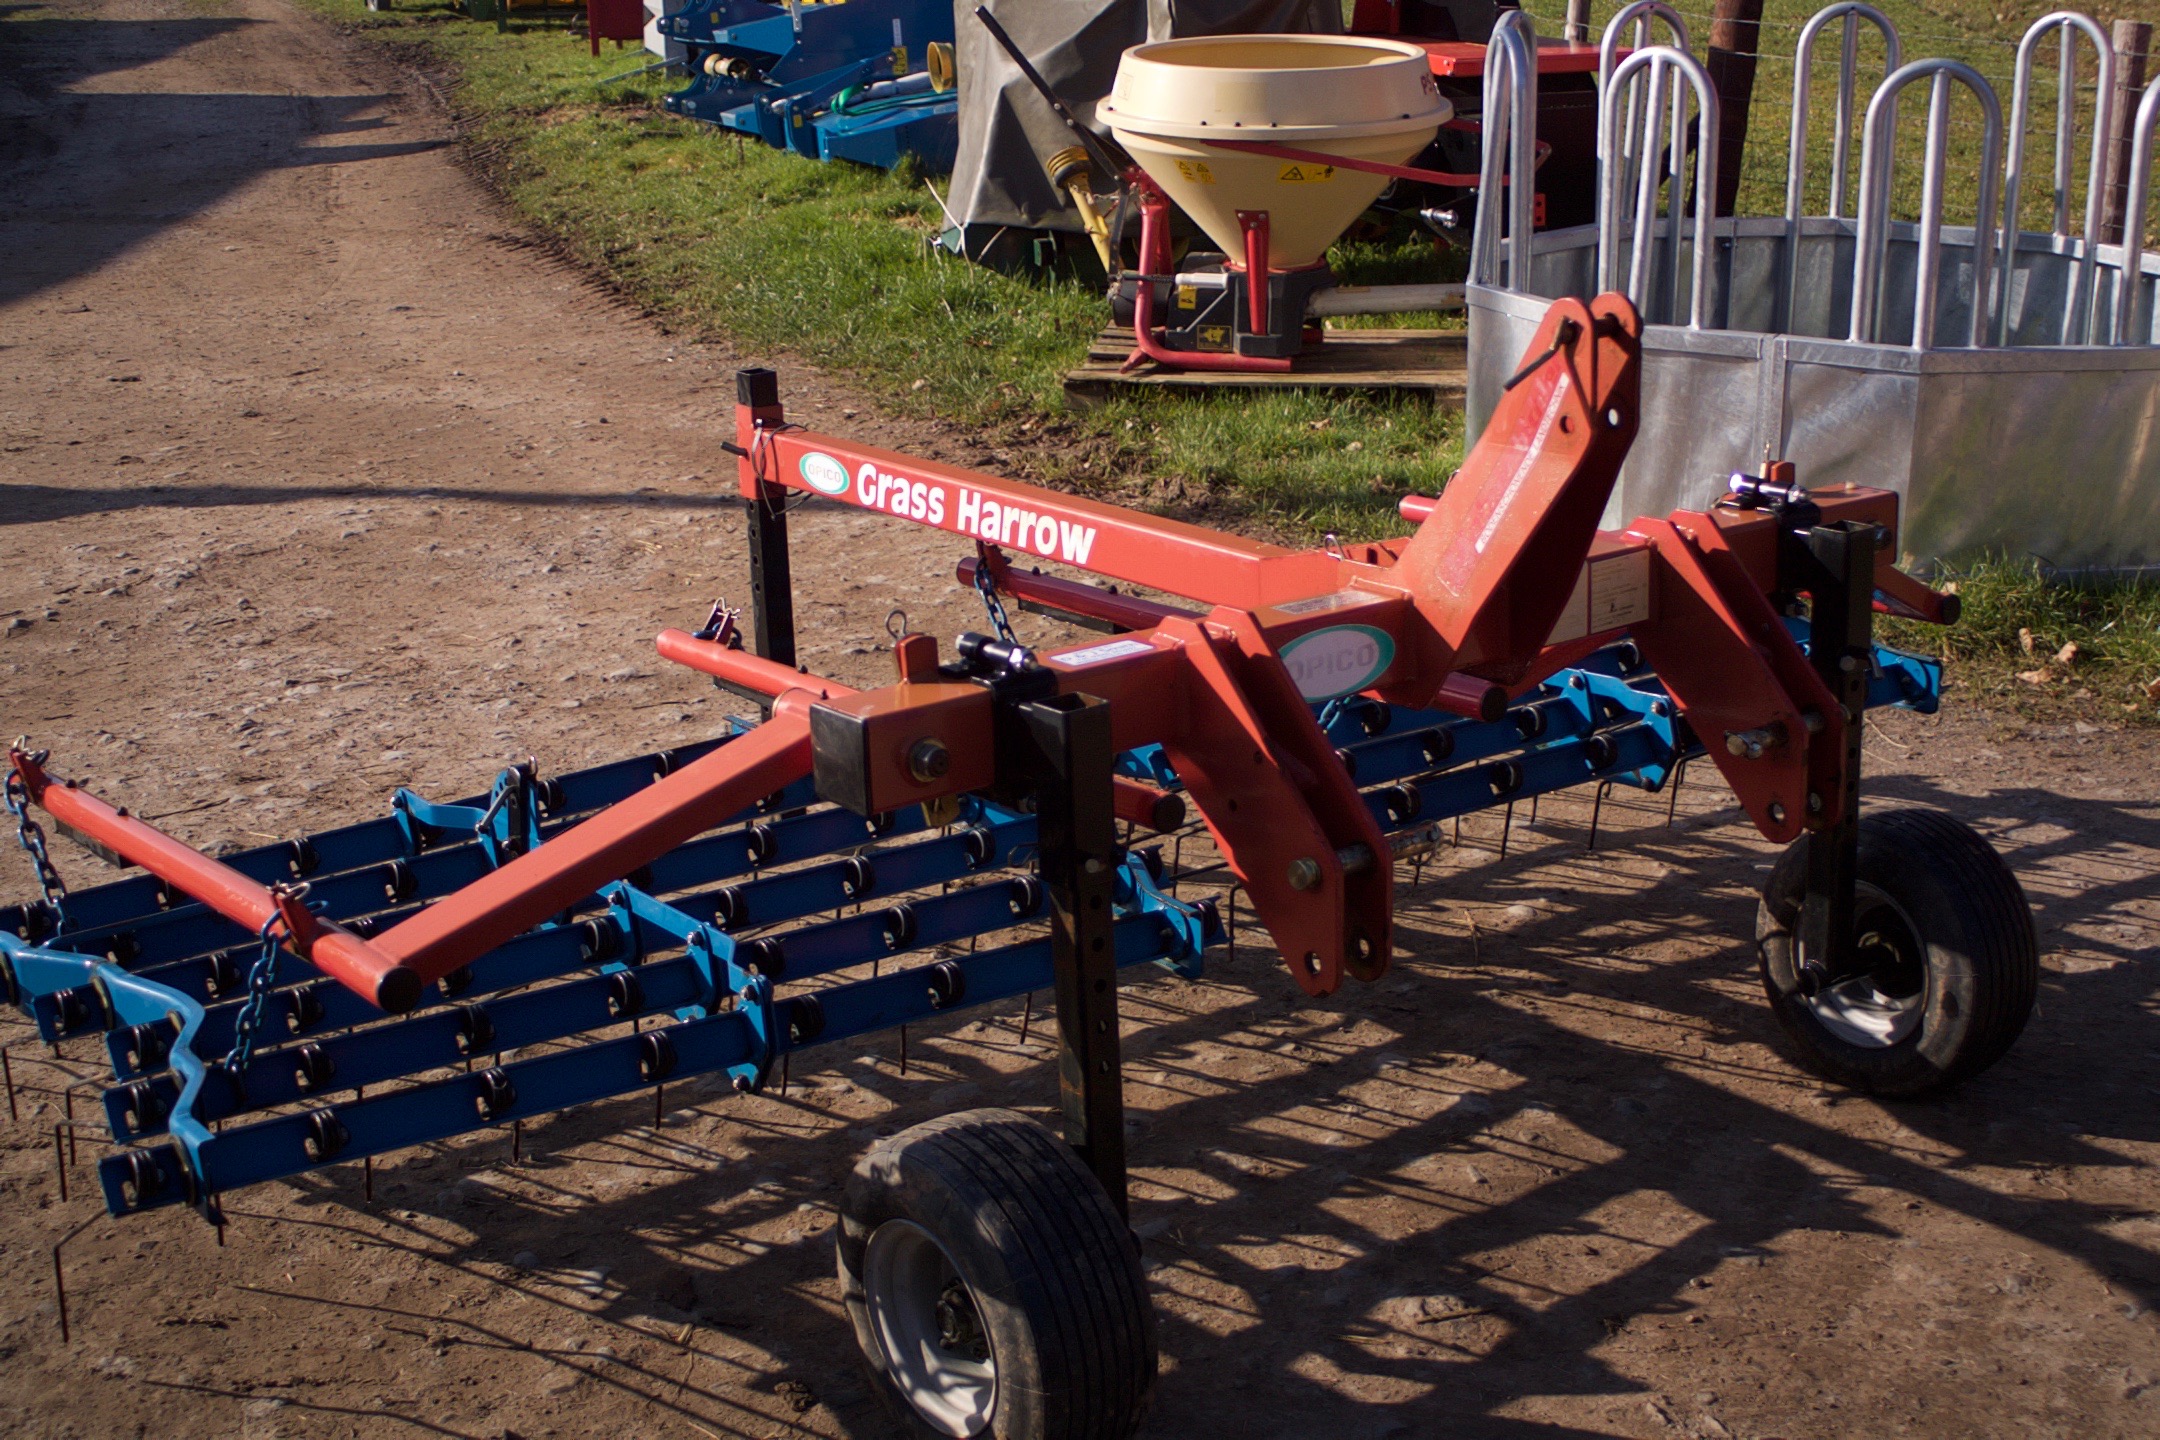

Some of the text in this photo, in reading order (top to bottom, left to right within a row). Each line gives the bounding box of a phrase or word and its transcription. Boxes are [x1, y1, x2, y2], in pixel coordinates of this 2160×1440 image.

[808, 464, 842, 483] OPICO
[857, 463, 1096, 565] Grass Harrow
